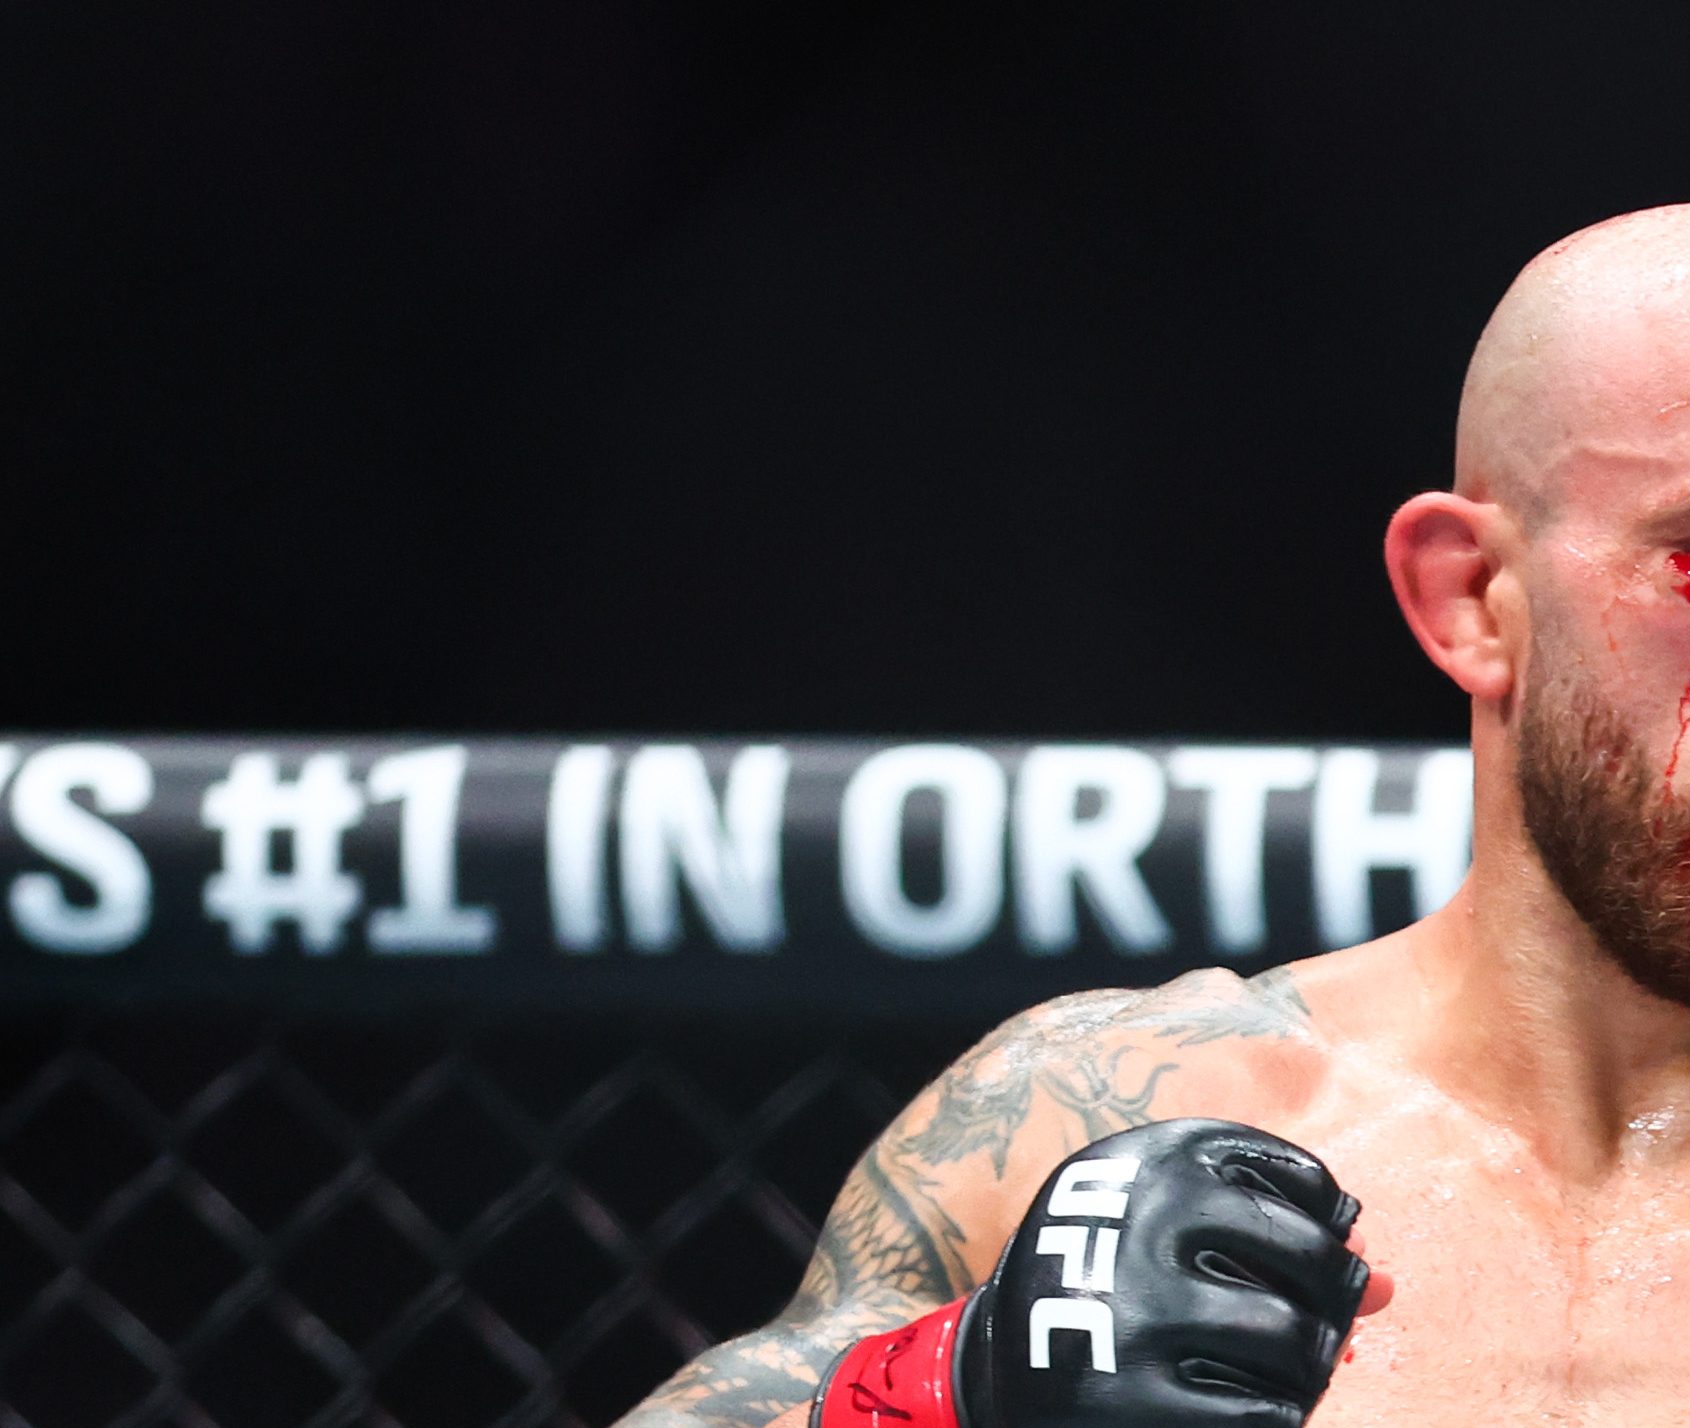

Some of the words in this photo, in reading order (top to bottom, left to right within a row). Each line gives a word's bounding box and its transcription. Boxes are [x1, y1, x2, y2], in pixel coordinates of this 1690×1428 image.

[202, 745, 498, 955] #1
[548, 743, 790, 955] IN
[1028, 1157, 1144, 1375] UFC
